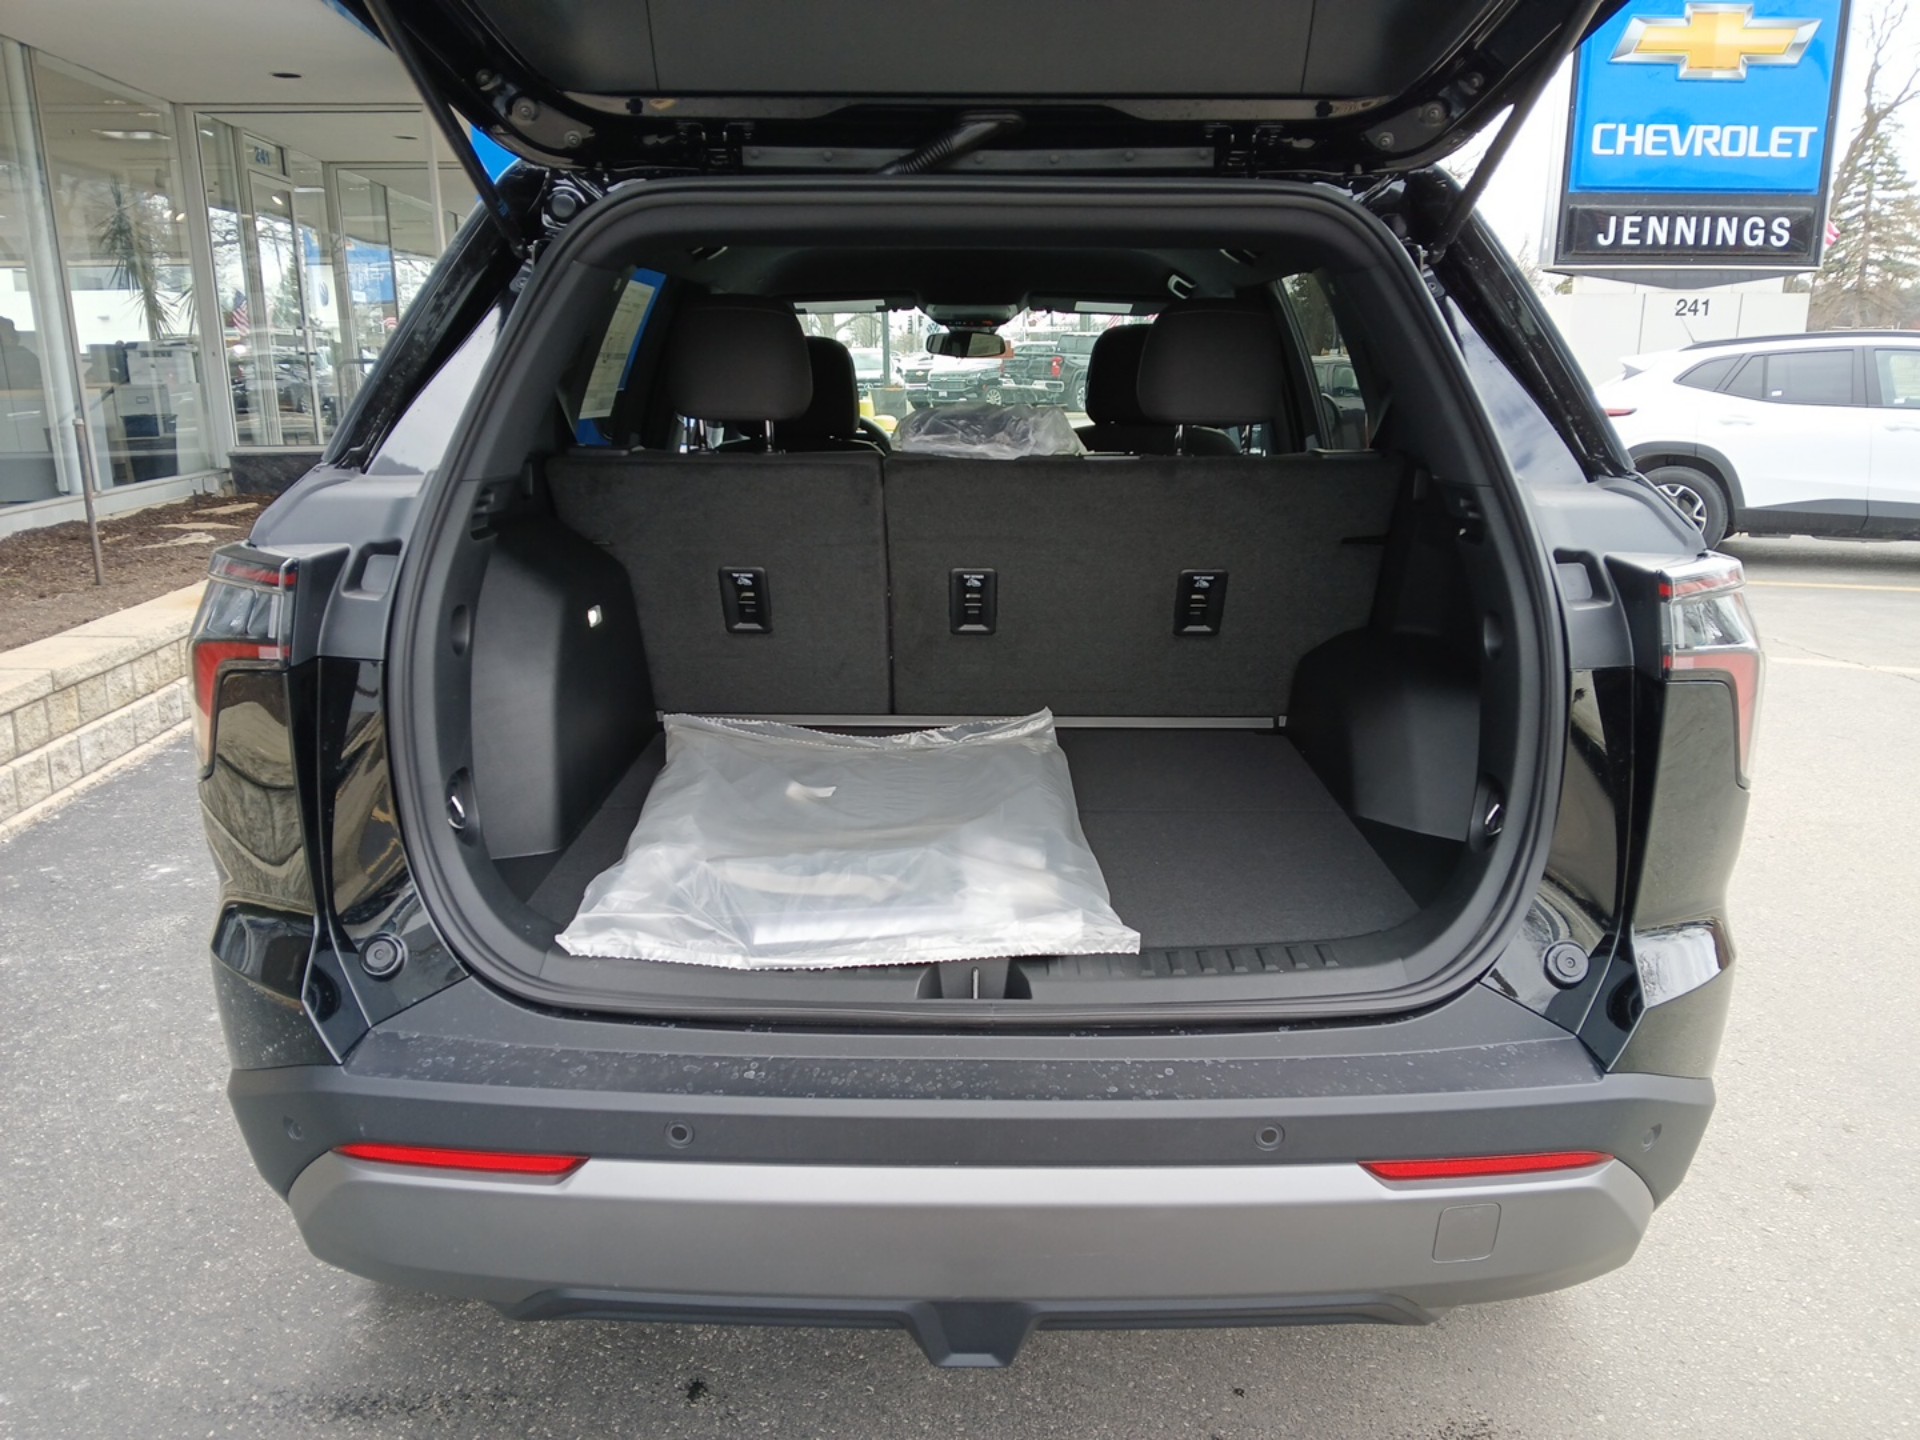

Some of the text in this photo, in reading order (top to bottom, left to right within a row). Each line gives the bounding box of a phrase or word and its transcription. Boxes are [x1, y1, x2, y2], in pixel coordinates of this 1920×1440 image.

[1592, 123, 1818, 158] CHEVROLET
[1597, 215, 1791, 247] JENNINGS
[1675, 298, 1710, 317] 241
